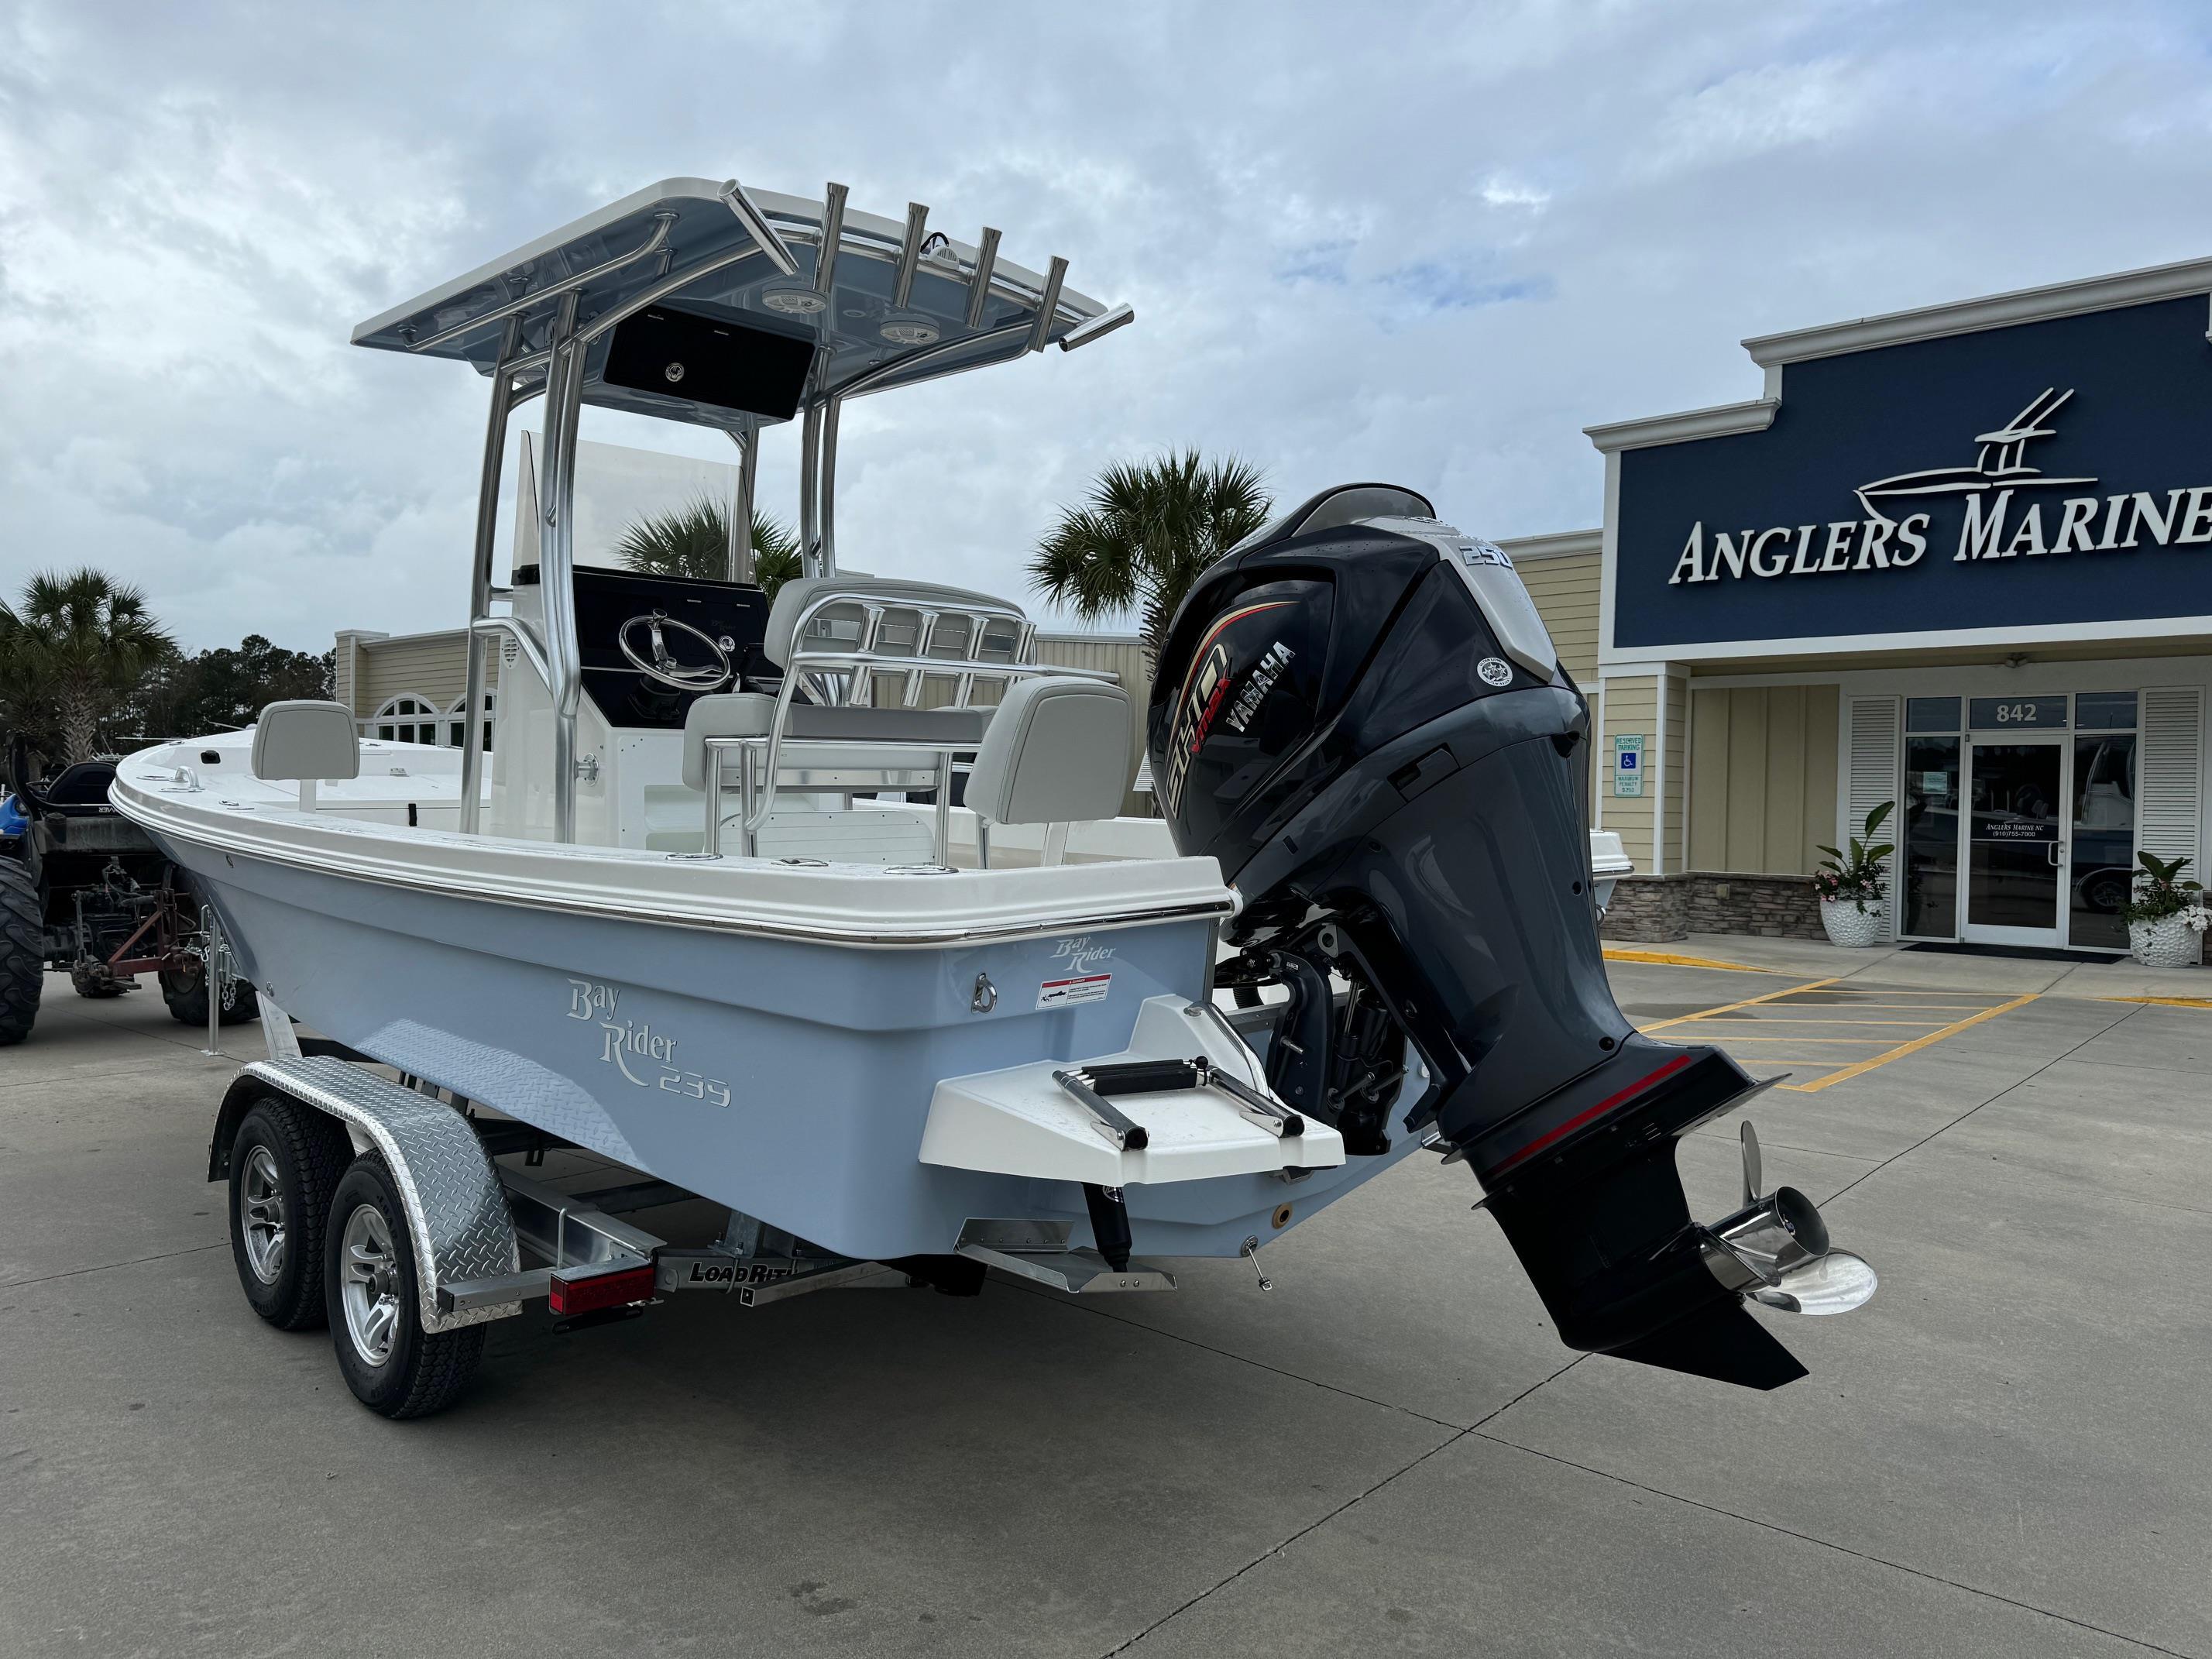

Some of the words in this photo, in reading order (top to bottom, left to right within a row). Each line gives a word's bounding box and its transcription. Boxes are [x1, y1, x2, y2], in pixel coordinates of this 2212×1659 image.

[1458, 545, 1514, 570] 250
[1668, 512, 1931, 585] ANGLERS
[1953, 487, 2212, 561] MARINE
[1225, 641, 1297, 733] YAMAHA
[1996, 703, 2037, 723] 842
[1049, 936, 1091, 958] Bay
[1063, 946, 1117, 974] Rider
[565, 977, 621, 1021] Bay
[598, 1019, 678, 1087] Rider
[659, 1065, 732, 1108] 239
